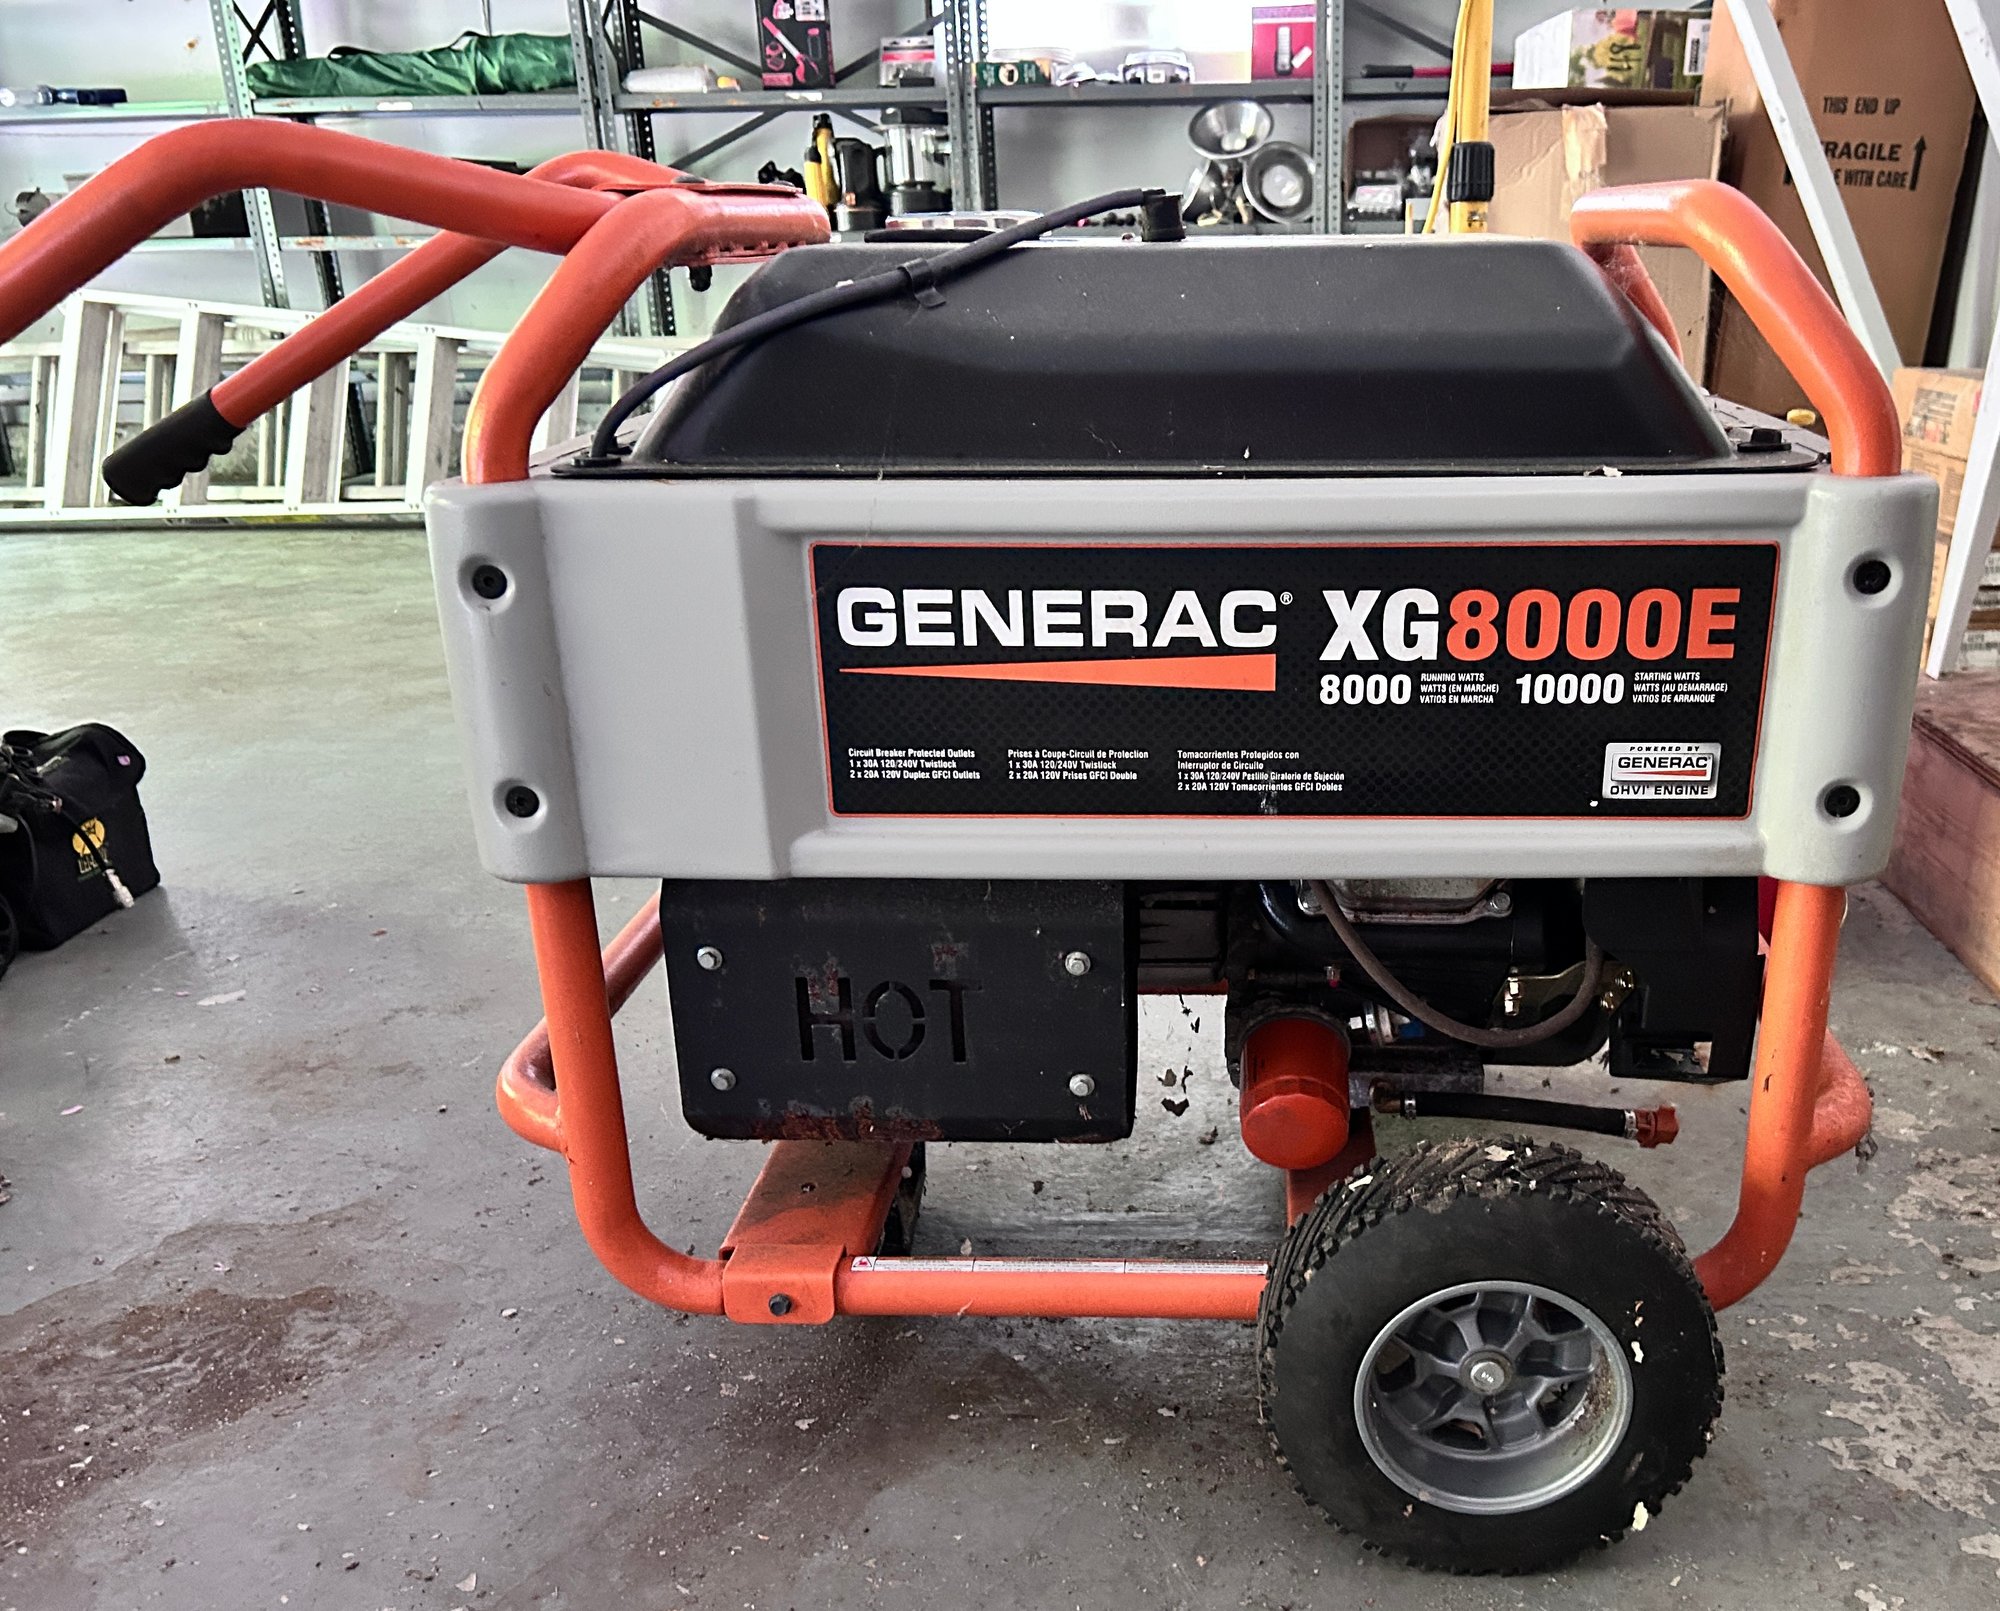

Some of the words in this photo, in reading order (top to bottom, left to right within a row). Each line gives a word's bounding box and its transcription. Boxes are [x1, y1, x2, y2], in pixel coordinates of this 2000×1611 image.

[1823, 97, 1848, 115] THIS
[1854, 97, 1879, 115] END
[1884, 98, 1901, 115] UP
[1821, 140, 1902, 162] RAGILE
[1844, 169, 1875, 187] WITH
[1876, 171, 1909, 189] CARE
[1319, 588, 1741, 662] XG8000E
[1420, 673, 1456, 681] RUNNING
[1457, 673, 1485, 681] WATTS
[1634, 672, 1672, 680] STARTING
[1673, 672, 1701, 680] WATTS
[1320, 674, 1411, 704] 8000
[1420, 684, 1447, 692] WATTS
[1448, 684, 1462, 693] (EN
[1463, 684, 1500, 693] MARCHE)
[1516, 674, 1624, 704] 10000
[1633, 683, 1660, 691] WATTS
[1661, 684, 1676, 693] (AU
[1419, 695, 1447, 703] VATIOS
[1448, 695, 1459, 703] EN
[1460, 695, 1494, 703] MARCHA
[1632, 694, 1660, 703] VATIOS
[1673, 694, 1716, 702] ARRANQUE
[848, 748, 874, 757] Circuit
[875, 749, 907, 757] Breaker
[907, 749, 946, 757] Protected
[947, 749, 976, 757] Outlets
[1007, 749, 1033, 758] Prises
[1041, 749, 1095, 760] Coupe-Circuit
[1096, 750, 1106, 758] de
[1108, 750, 1149, 758] Protection
[1177, 750, 1239, 758] Tomacorrientes
[1240, 751, 1283, 760] Protegidos
[862, 759, 879, 767] 30A
[880, 759, 919, 768] 120/240V
[919, 760, 957, 768] Twistlock
[1008, 760, 1013, 768] 1
[1022, 760, 1039, 768] 30A
[1039, 760, 1078, 769] 120/240V
[1079, 761, 1117, 769] Twistlock
[1177, 761, 1220, 771] Interruptor
[1221, 761, 1231, 769] de
[1233, 761, 1264, 769] Circuito
[849, 770, 856, 778] 2
[863, 770, 880, 778] 20A
[881, 770, 901, 778] 120V
[902, 770, 931, 780] Duplex
[931, 770, 951, 779] GFCI
[952, 771, 981, 779] Outlets
[1008, 771, 1015, 779] 2
[1022, 771, 1039, 779] 20A
[1040, 771, 1061, 779] 120V
[1062, 771, 1088, 779] Prises
[1088, 771, 1109, 780] GFCI
[1109, 771, 1138, 779] Double
[1190, 772, 1205, 780] 30A
[1206, 772, 1241, 780] 120/240V
[1241, 772, 1270, 781] Pestillo
[1269, 772, 1302, 781] Giratorio
[1301, 772, 1313, 781] de
[1177, 782, 1183, 790] 2
[1191, 782, 1208, 790] 20A
[1230, 782, 1294, 791] Tomacorrientes
[1294, 782, 1314, 791] GFCI
[1315, 783, 1343, 791] Dobles
[1653, 786, 1710, 795] ENGINE
[795, 976, 983, 1063] HOT
